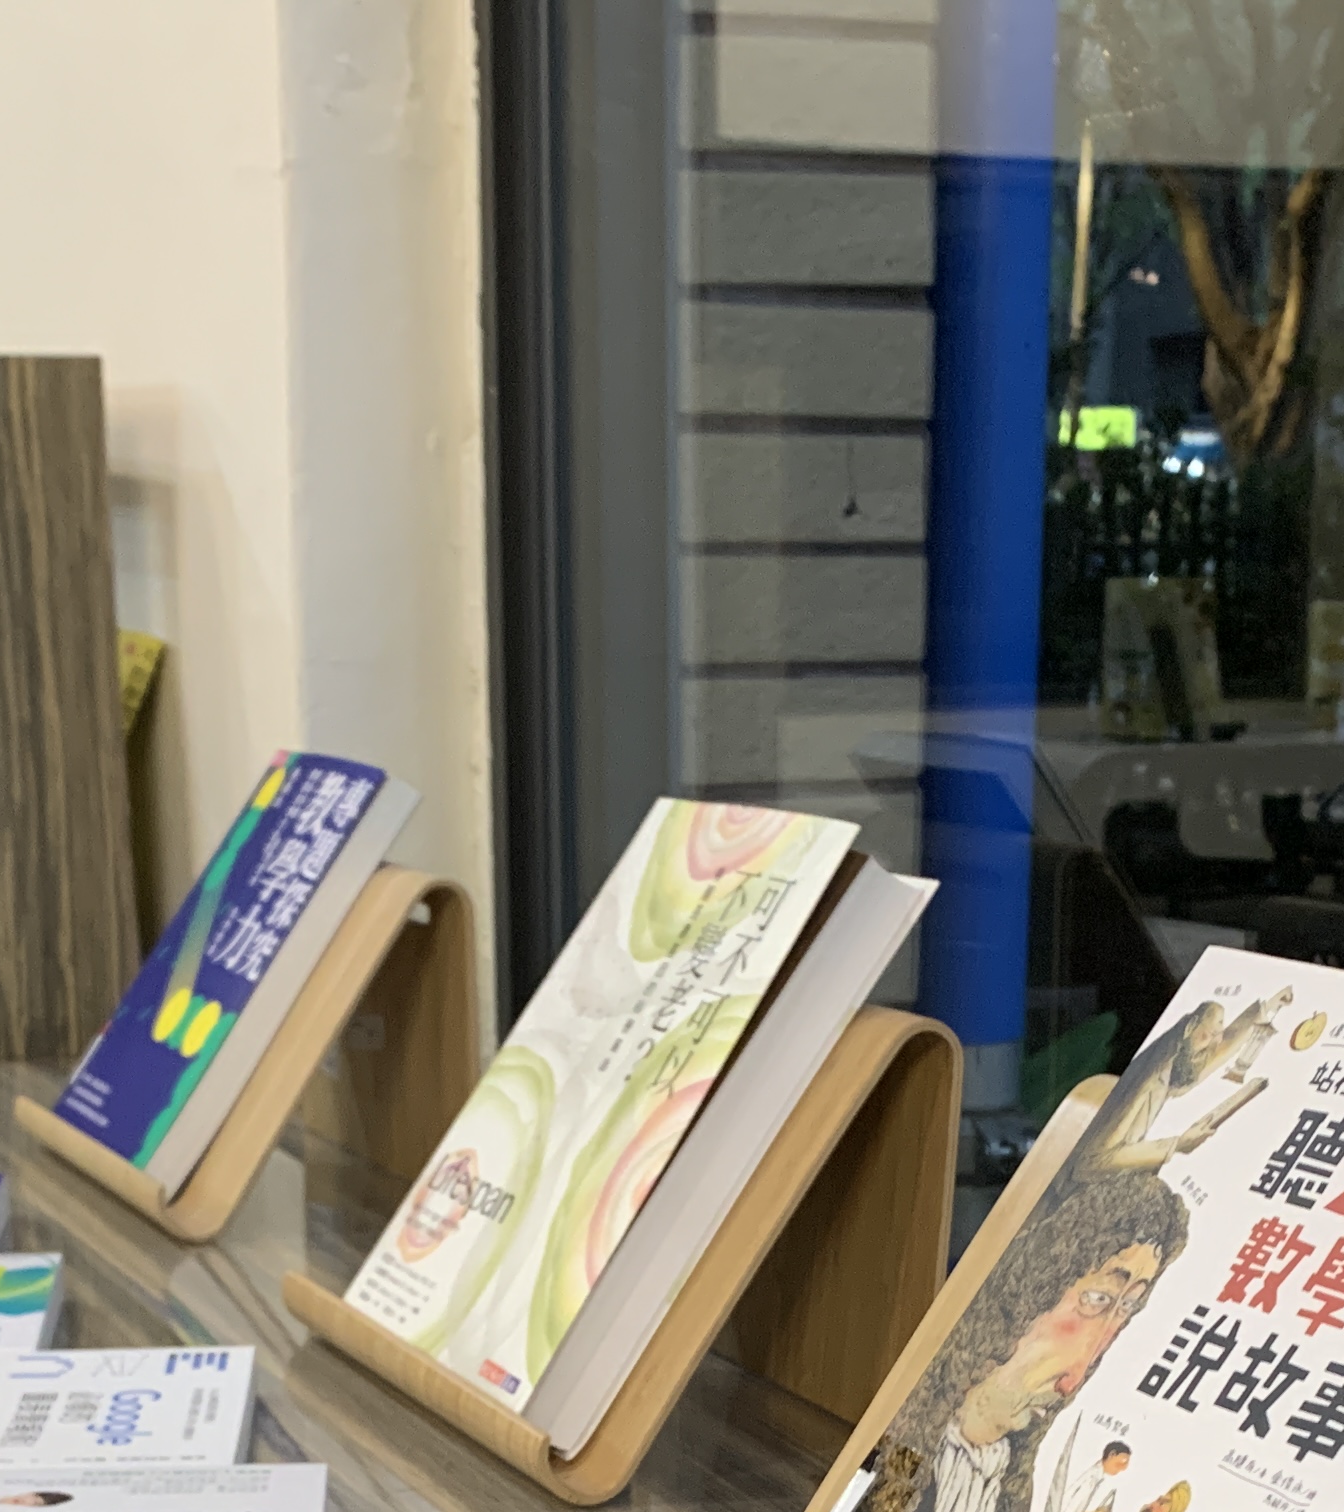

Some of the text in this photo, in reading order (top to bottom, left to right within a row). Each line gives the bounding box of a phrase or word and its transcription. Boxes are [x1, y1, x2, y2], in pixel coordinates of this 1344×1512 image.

[649, 875, 797, 1099] 可不可以
[85, 1388, 162, 1446] Google
